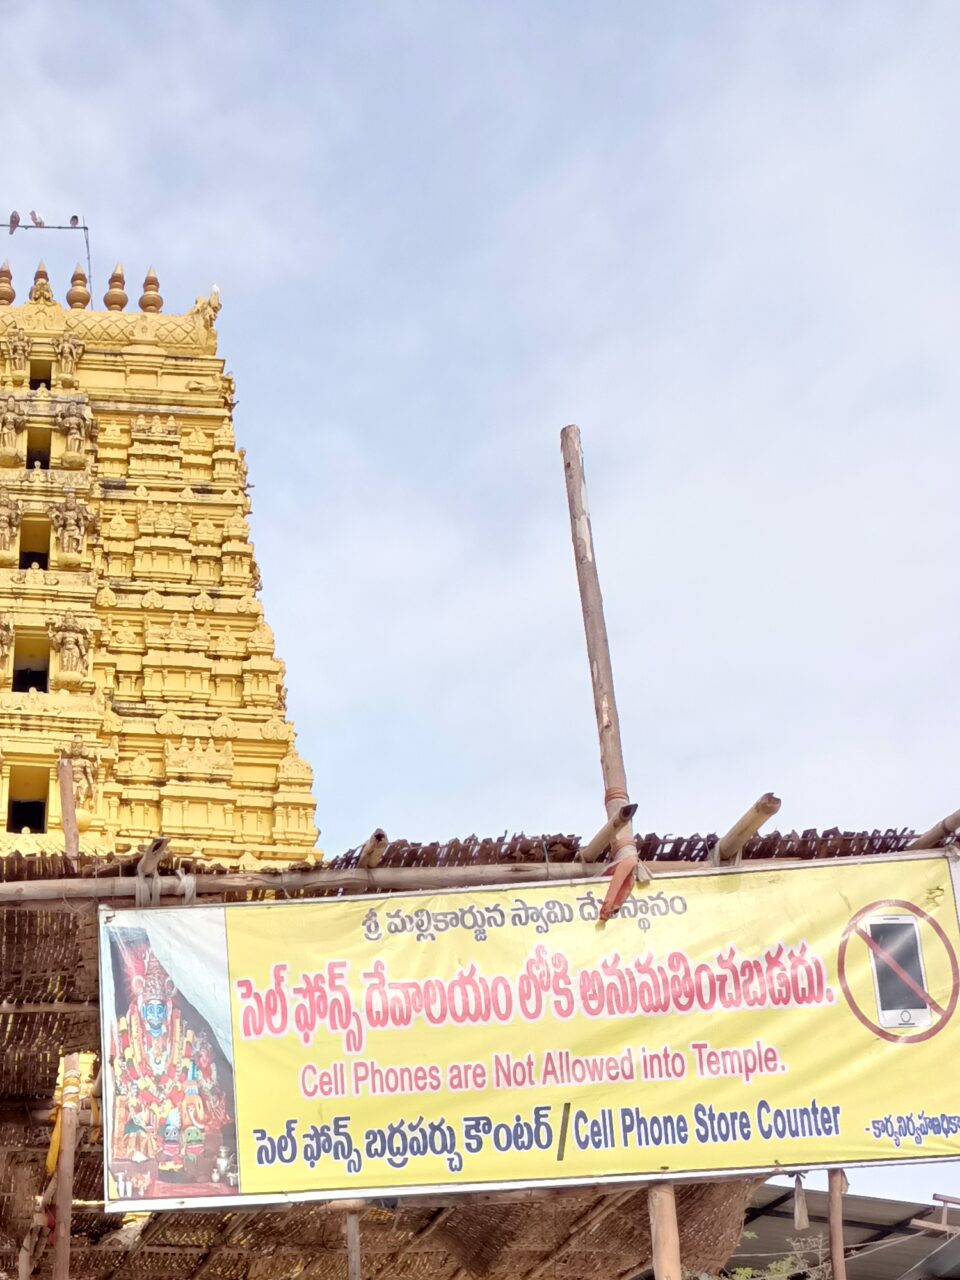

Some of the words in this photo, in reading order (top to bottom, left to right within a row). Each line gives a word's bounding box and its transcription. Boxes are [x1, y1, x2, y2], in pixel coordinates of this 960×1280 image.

[362, 908, 382, 941] శ్రీ
[387, 902, 505, 942] మల్లికార్జున
[511, 899, 573, 933] స్వామి
[576, 891, 688, 933] దేస్థానం
[237, 964, 288, 1037] సెల్
[293, 961, 363, 1052] ఫోన్స్
[363, 959, 513, 1028] దేవాలయం
[518, 944, 575, 1019] లోకి
[580, 942, 834, 1016] అనుమతించబడదు.
[301, 1063, 345, 1097] Cell
[354, 1061, 441, 1094] Phones
[449, 1063, 486, 1089] are
[494, 1054, 536, 1088] Not
[542, 1048, 635, 1085] Allowed
[641, 1046, 685, 1079] into
[692, 1040, 786, 1082] Temple.
[253, 1119, 298, 1165] సెల్
[302, 1116, 362, 1173] ఫోన్స్
[463, 1105, 553, 1153] కౌంటర్
[574, 1108, 615, 1150] Cell
[620, 1106, 689, 1147] Phone
[693, 1103, 752, 1143] Store
[756, 1098, 840, 1140] Counter
